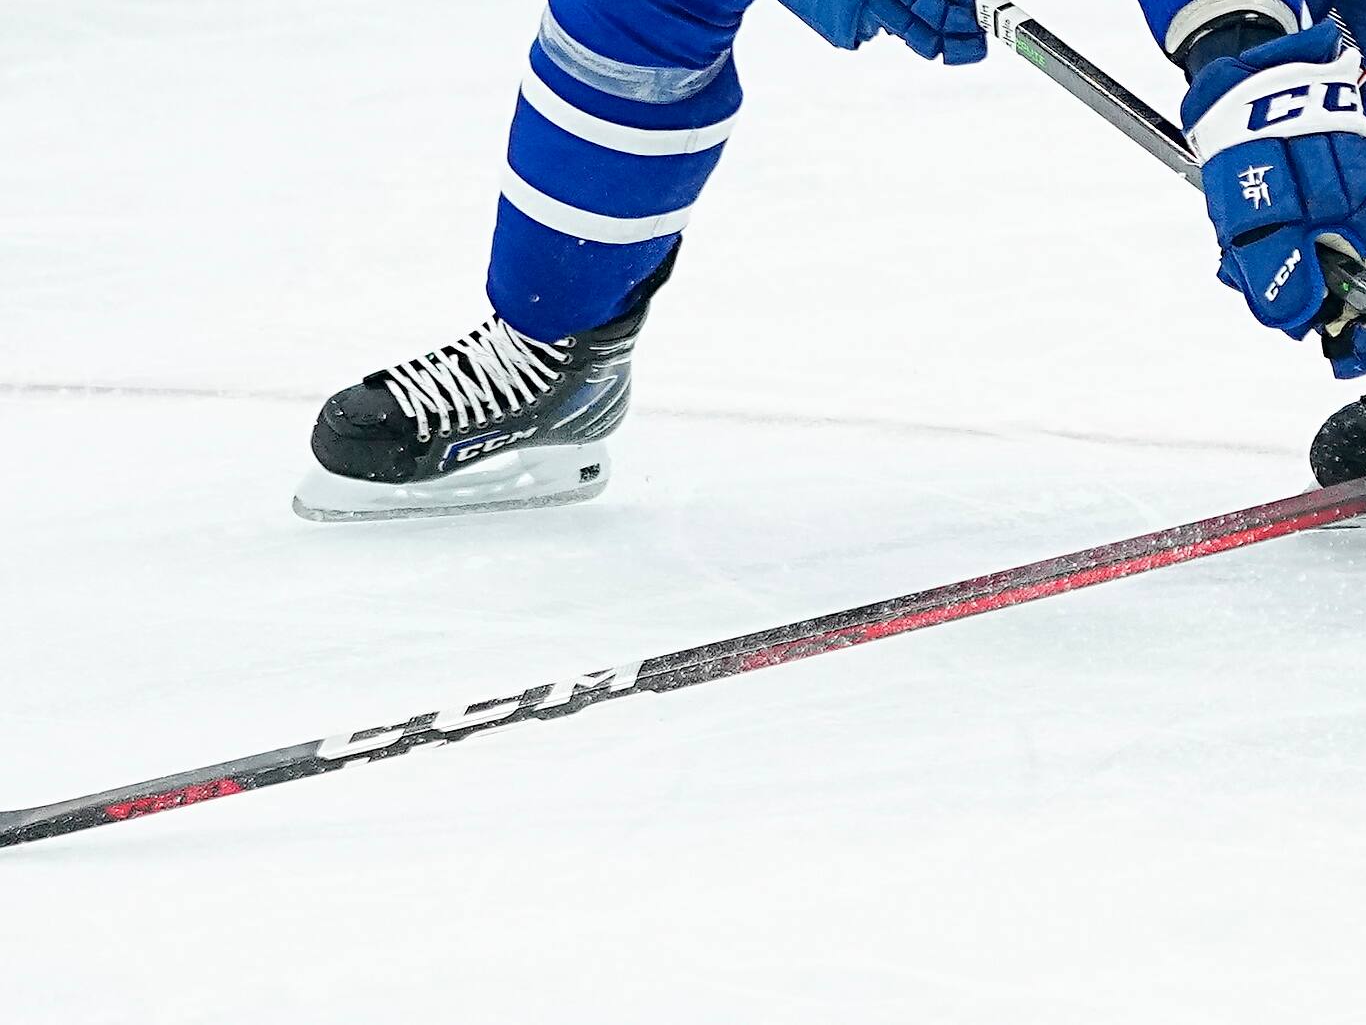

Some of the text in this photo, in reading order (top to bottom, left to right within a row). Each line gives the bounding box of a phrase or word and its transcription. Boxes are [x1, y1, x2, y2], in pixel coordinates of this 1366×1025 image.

[1264, 248, 1303, 302] CCM
[455, 426, 540, 463] CCM
[316, 660, 645, 771] CCM
